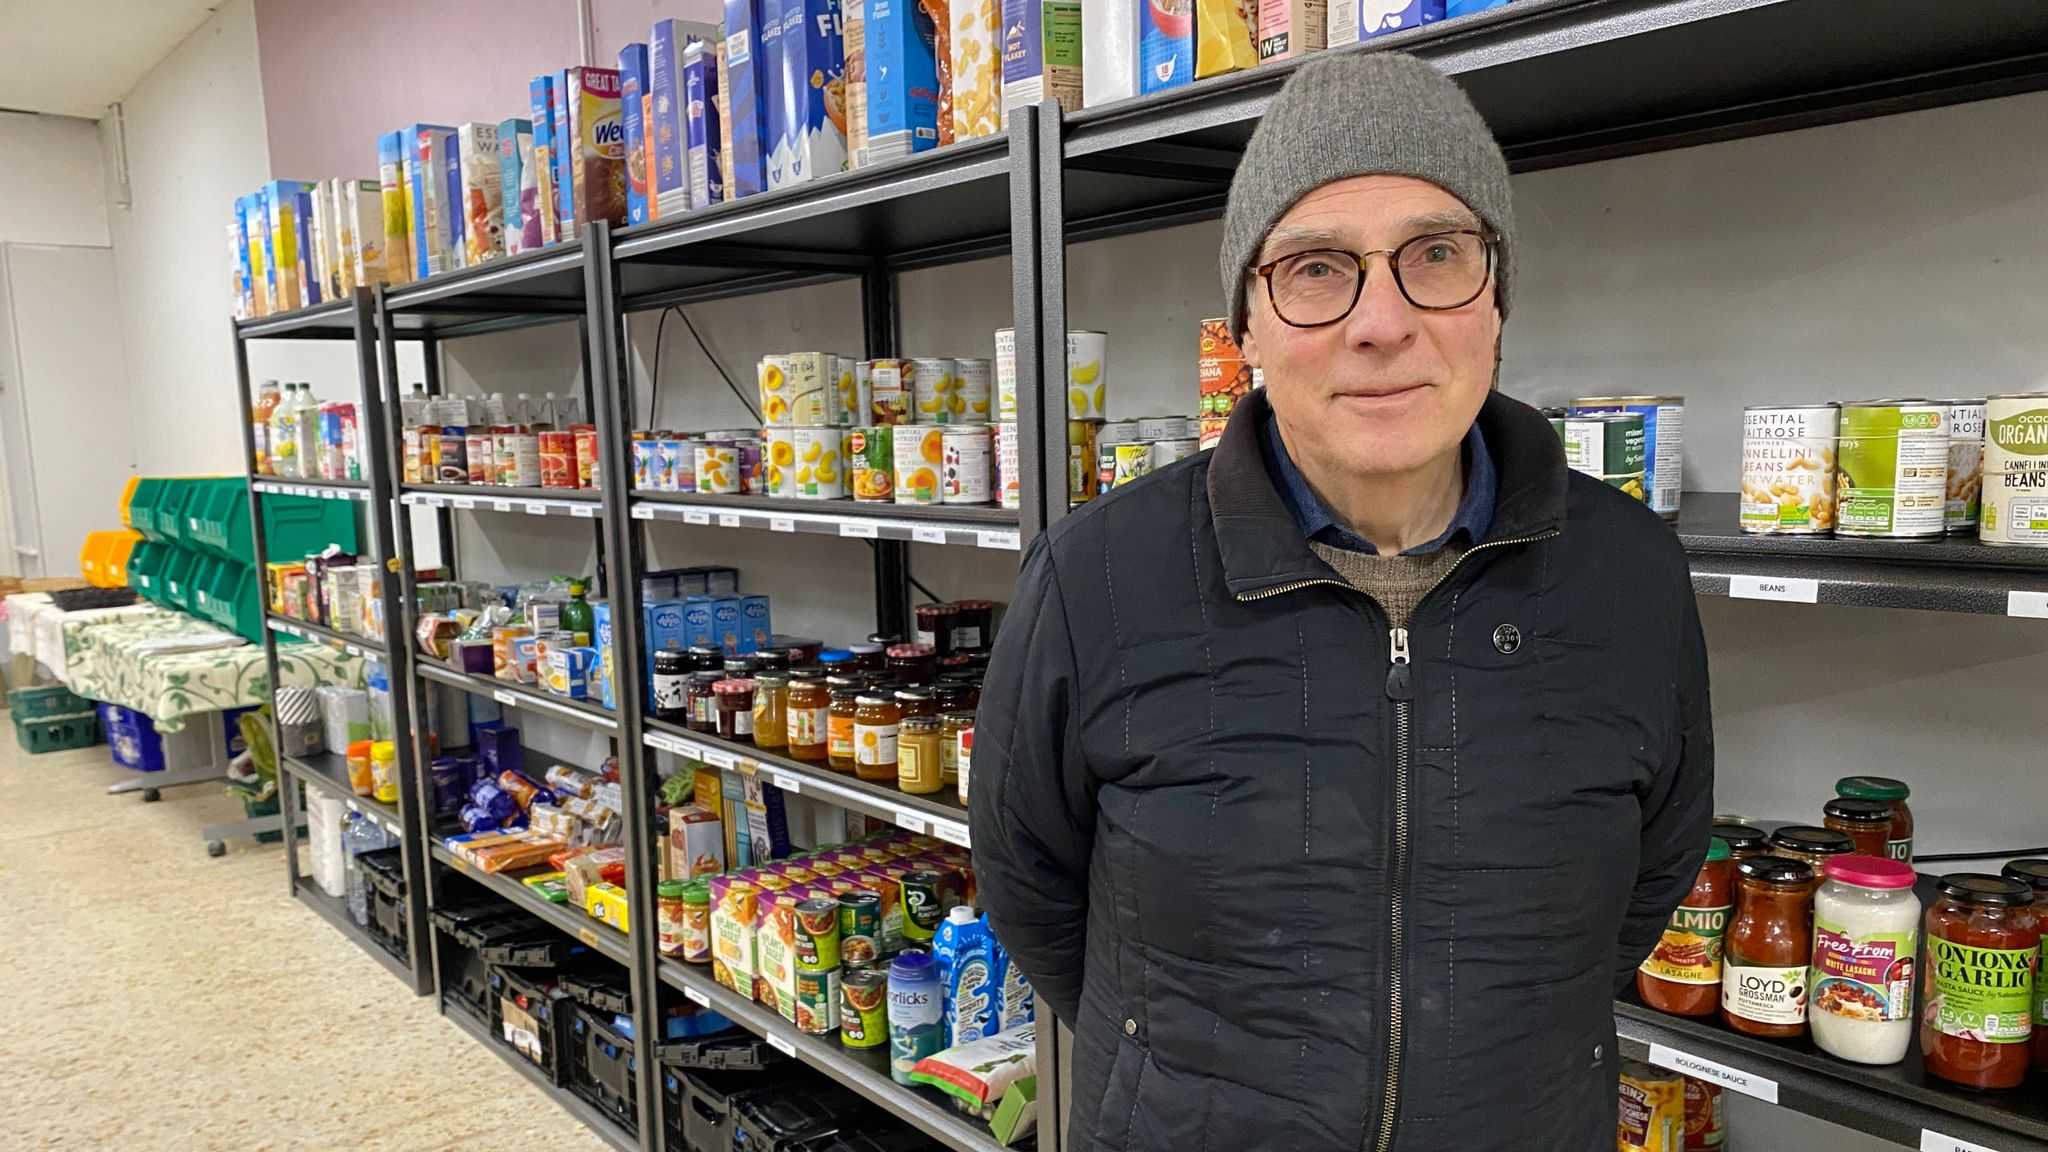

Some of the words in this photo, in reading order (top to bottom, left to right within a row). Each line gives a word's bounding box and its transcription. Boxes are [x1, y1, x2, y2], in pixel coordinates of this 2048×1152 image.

[761, 26, 781, 43] FLAKES
[585, 73, 609, 91] GREAT
[1625, 429, 1643, 437] mixed
[1745, 427, 1806, 438] AITROSE
[1759, 475, 1815, 485] WATER
[2004, 472, 2046, 487] BEANS
[1759, 583, 1786, 593] BEANS
[1817, 934, 1850, 952] Free
[1850, 943, 1894, 957] From
[1669, 954, 1696, 964] TOMATO
[1660, 967, 1703, 979] LASAGNE
[1825, 958, 1844, 971] WHITE
[1845, 964, 1877, 976] LASAGNE
[1938, 961, 2030, 988] GARLIC
[1740, 973, 1785, 994] LOYD
[887, 991, 928, 1005] orlicks
[1738, 988, 1785, 1003] GROSSMAN
[1958, 986, 1985, 997] SAUCE
[1675, 1057, 1720, 1078] BOLOGNESE
[1721, 1072, 1748, 1087] SAUCE
